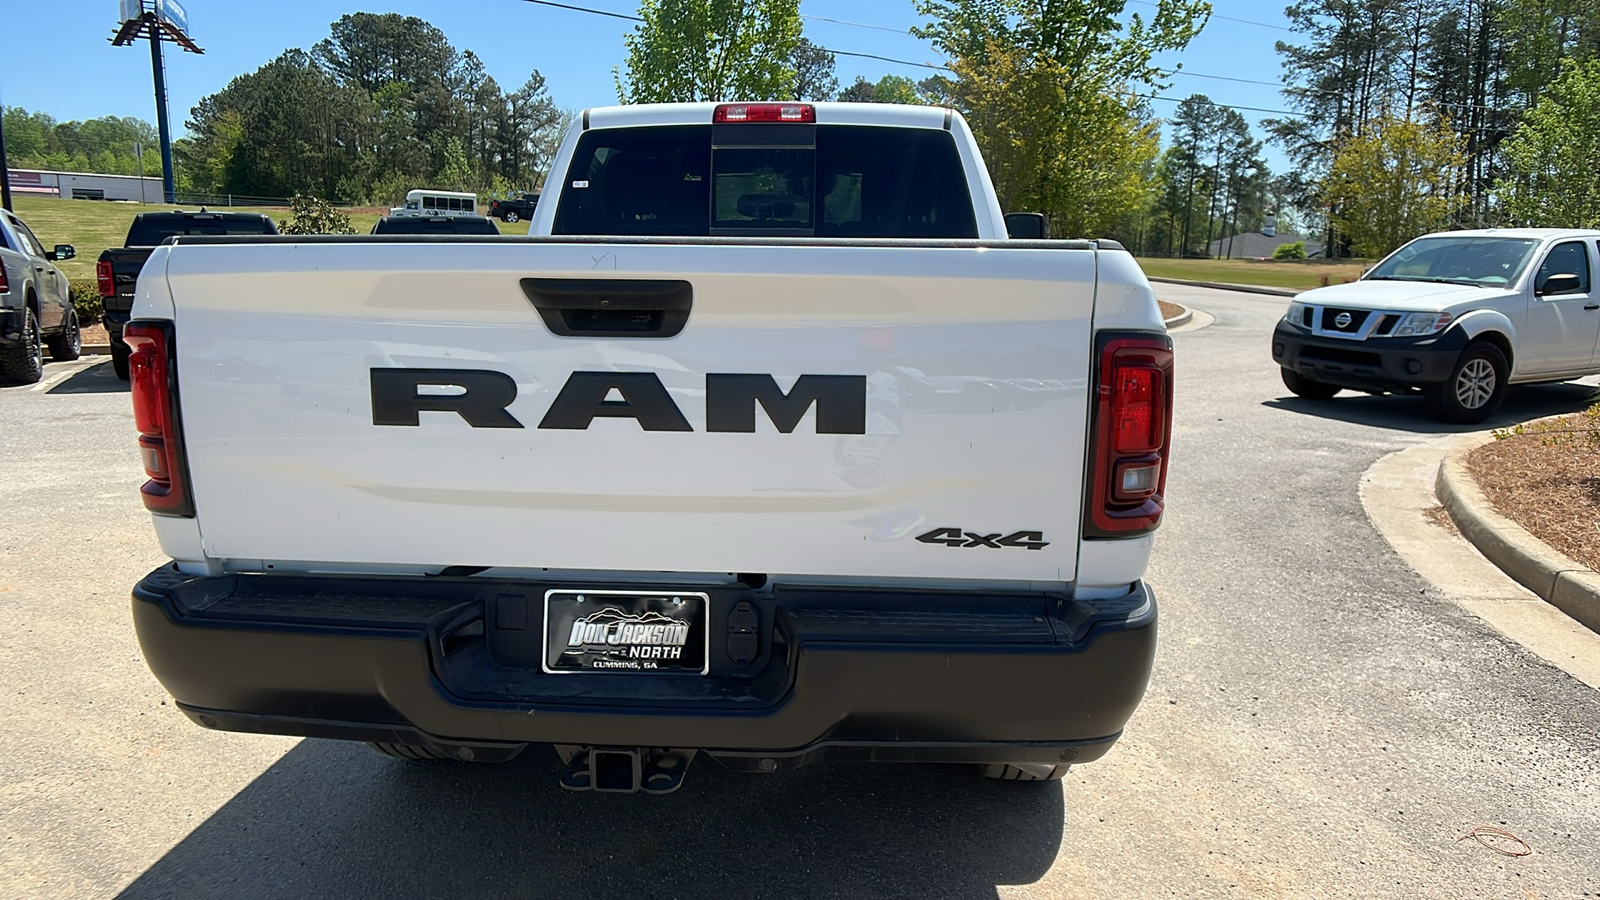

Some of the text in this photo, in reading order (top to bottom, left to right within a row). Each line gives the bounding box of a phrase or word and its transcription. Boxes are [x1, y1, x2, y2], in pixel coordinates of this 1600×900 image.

[370, 367, 867, 434] RAM
[914, 527, 1050, 550] 4x4
[568, 621, 689, 646] DON JACKSON
[629, 646, 681, 659] NORTH
[593, 661, 641, 669] CUMMING,
